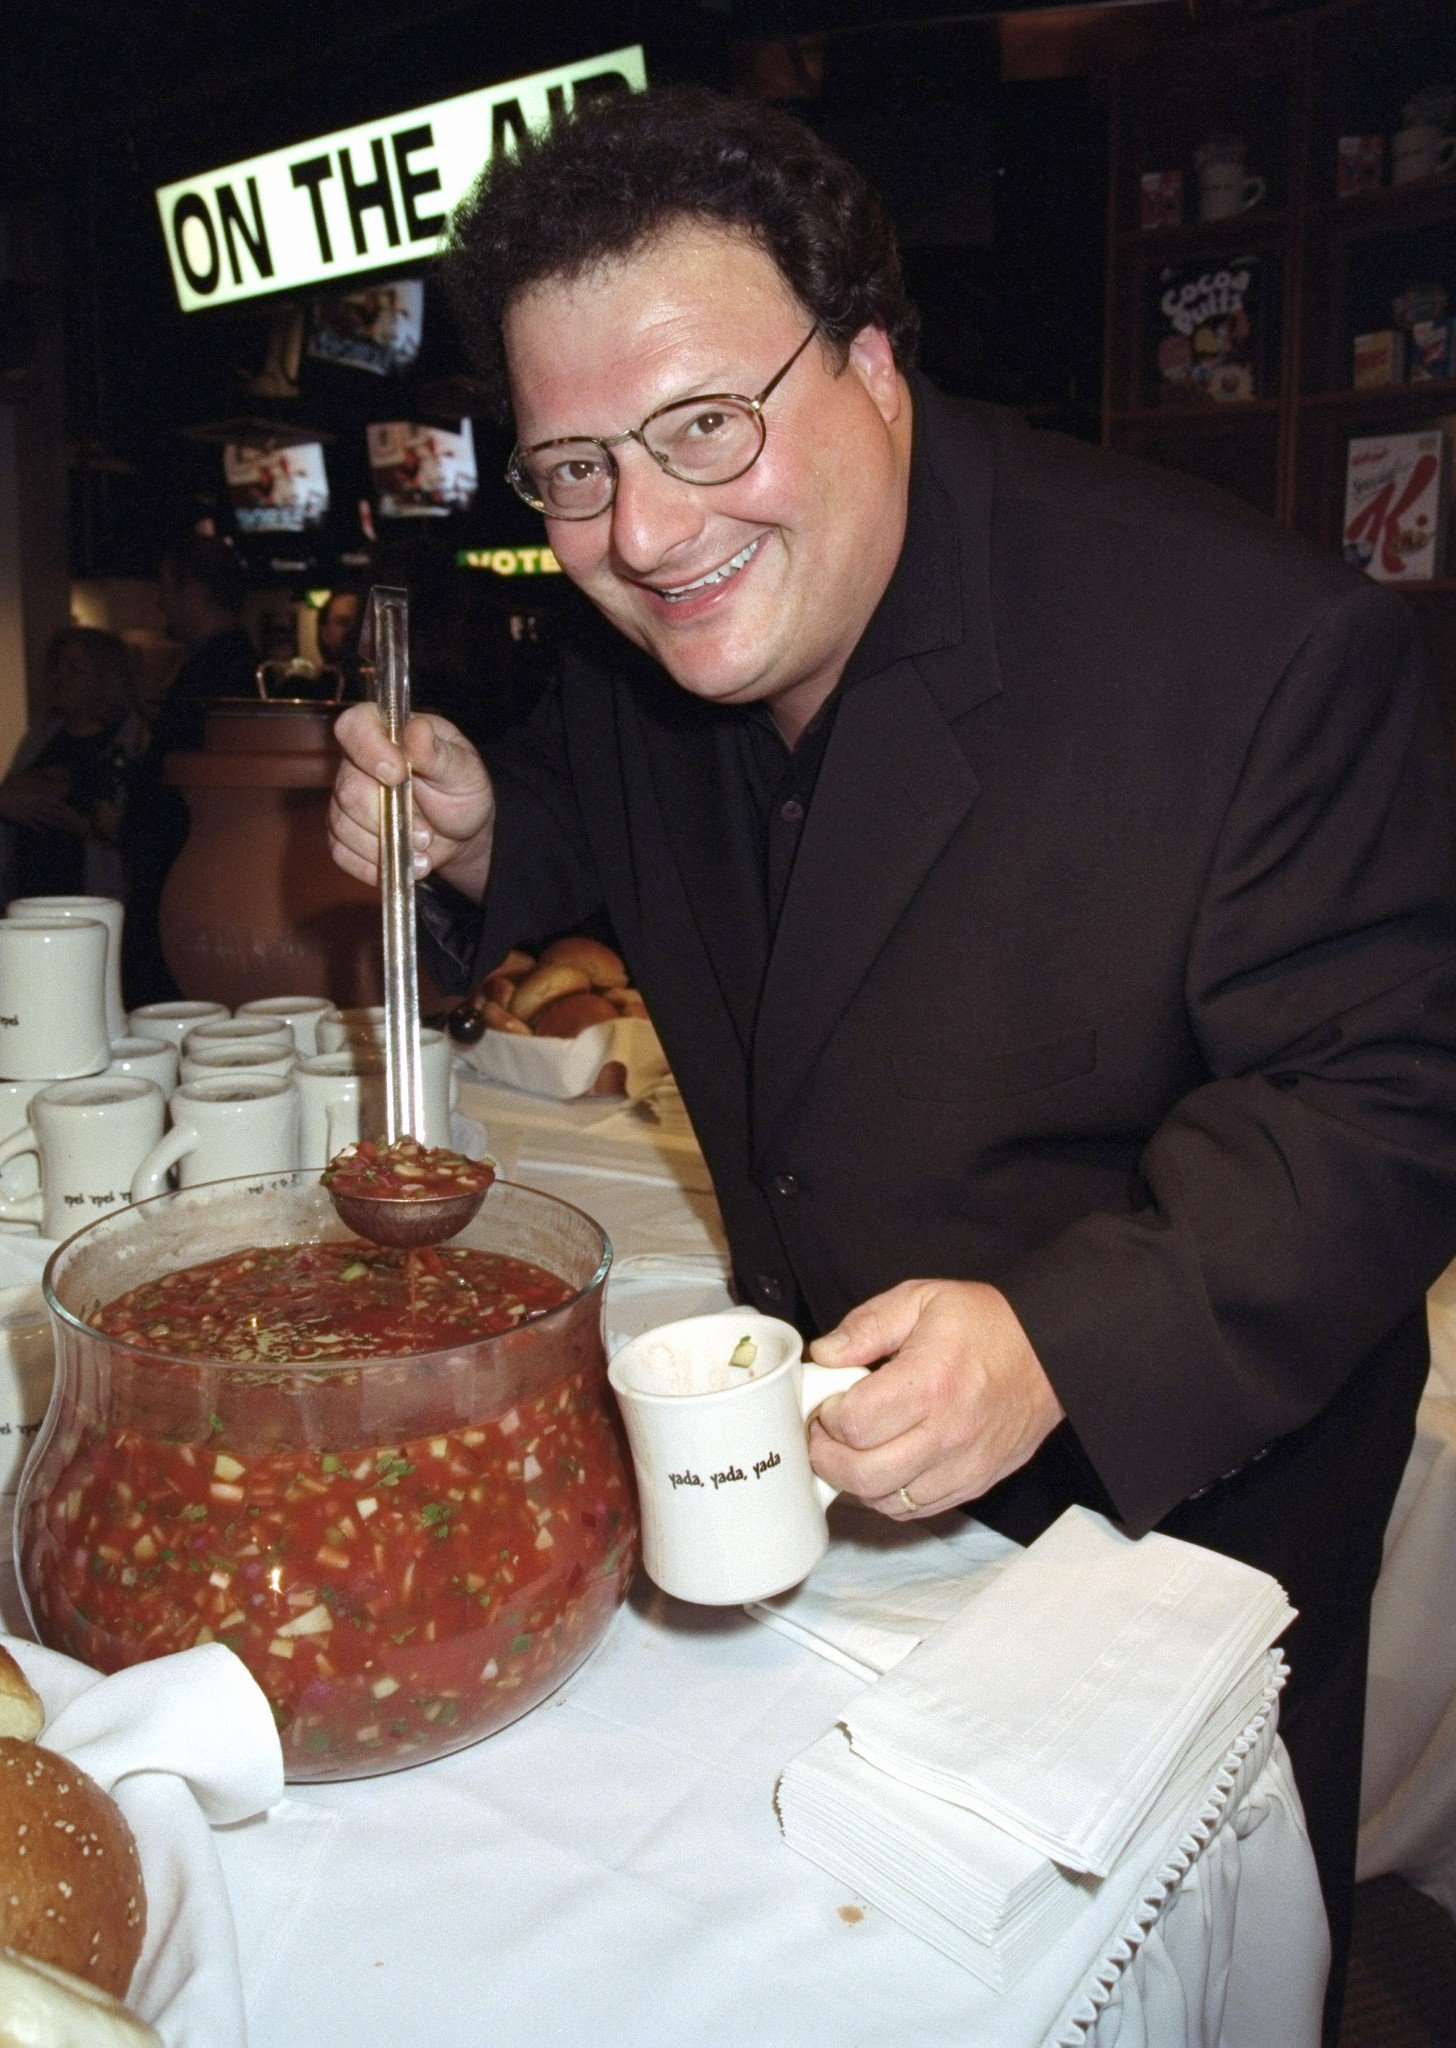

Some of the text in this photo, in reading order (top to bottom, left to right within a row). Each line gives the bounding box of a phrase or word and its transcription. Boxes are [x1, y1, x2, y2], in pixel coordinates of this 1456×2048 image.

[172, 123, 447, 296] ON THE
[668, 1451, 781, 1490] yada, yada, yada
